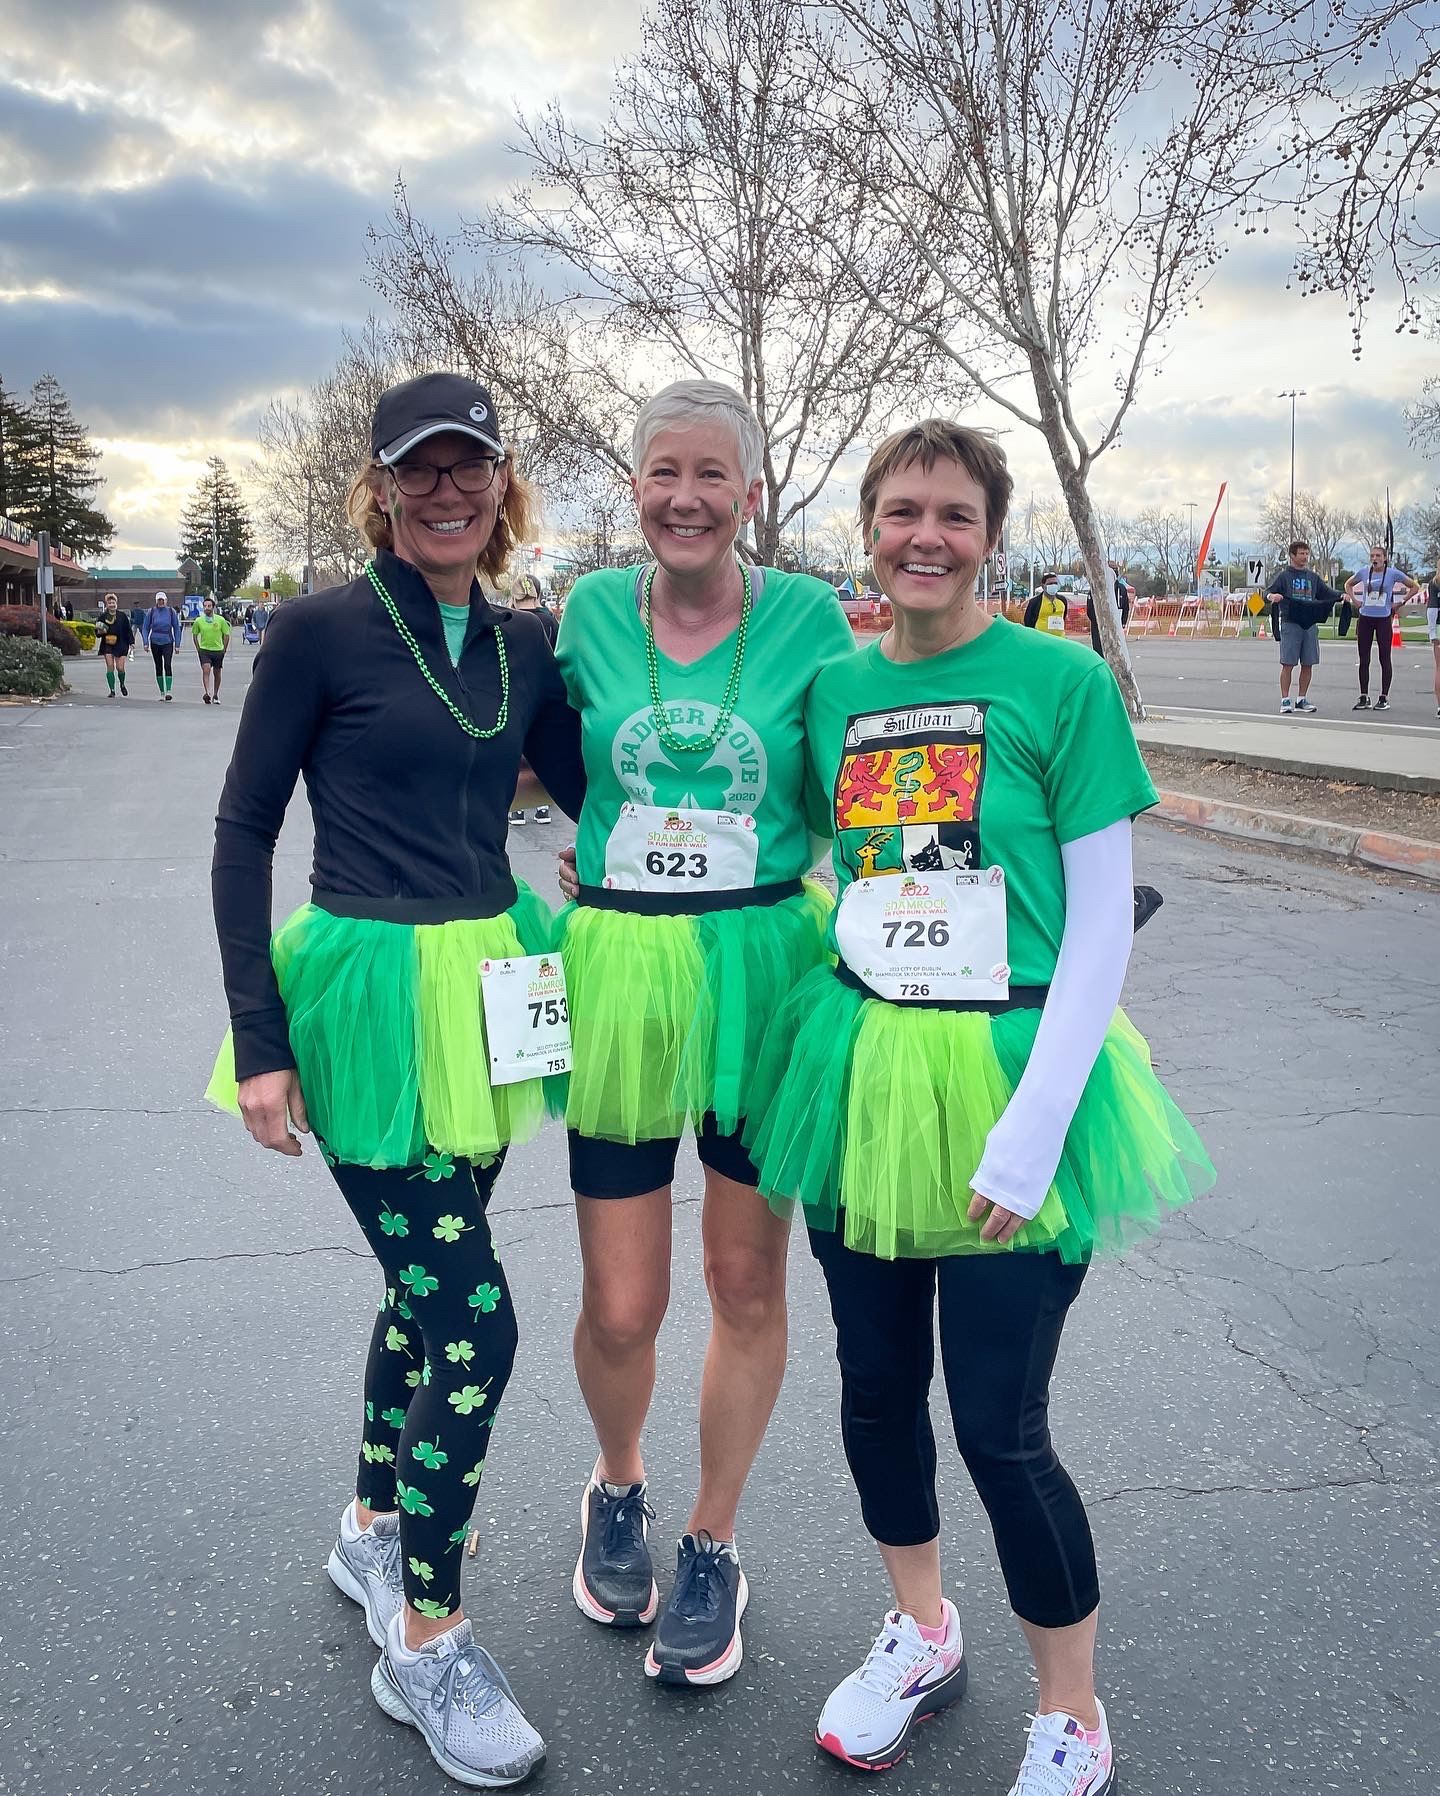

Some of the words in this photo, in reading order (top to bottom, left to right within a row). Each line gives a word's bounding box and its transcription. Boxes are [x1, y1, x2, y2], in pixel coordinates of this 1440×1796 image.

[883, 712, 953, 734] Sullivan
[718, 714, 760, 784] OVE
[728, 792, 756, 801] 2020
[663, 819, 692, 831] 2022
[647, 831, 708, 843] SHAMROCK
[646, 851, 708, 878] 623
[900, 884, 930, 897] 2022
[885, 897, 948, 912] SHAMROCK
[882, 920, 950, 948] 726
[539, 965, 559, 978] 2022
[527, 979, 564, 993] SHAMRO
[900, 984, 930, 996] 726
[528, 997, 568, 1029] 753
[547, 1058, 566, 1073] 753
